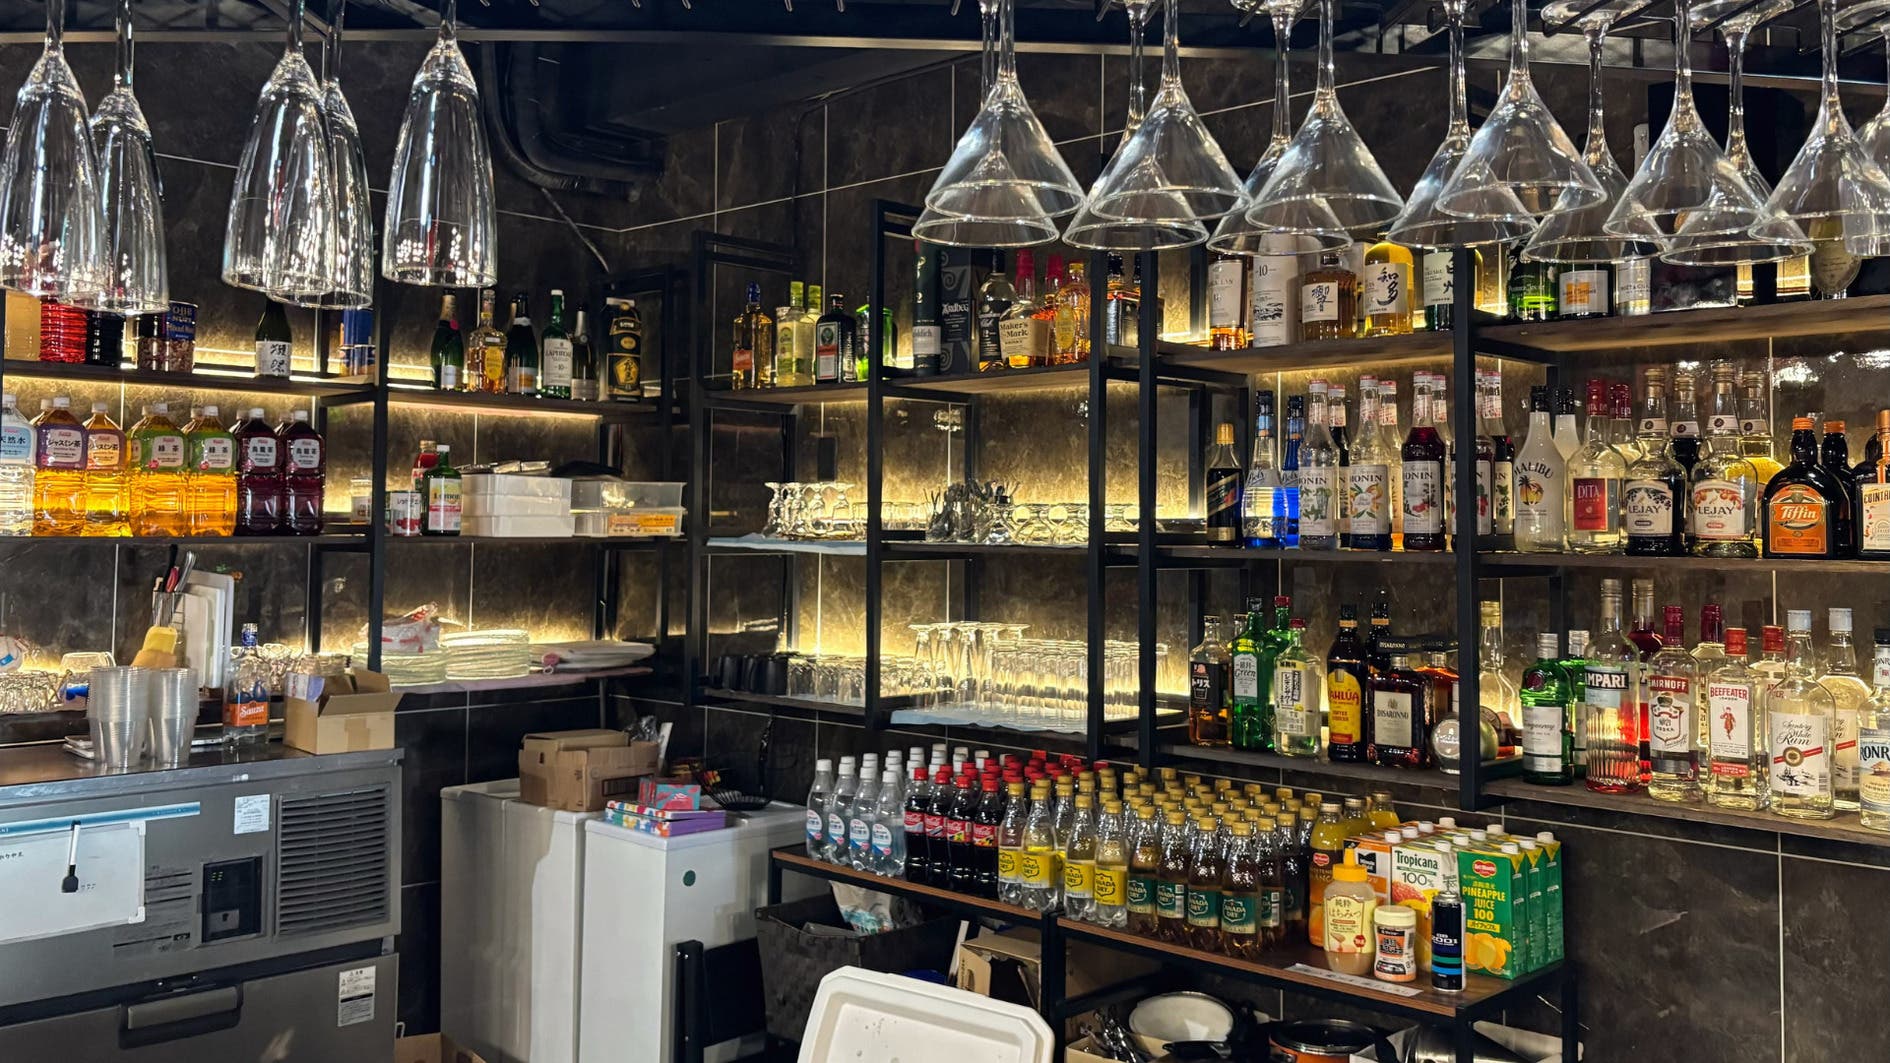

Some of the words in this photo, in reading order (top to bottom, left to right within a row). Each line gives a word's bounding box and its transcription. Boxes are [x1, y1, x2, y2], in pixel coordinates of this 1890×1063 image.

[1259, 264, 1268, 276] 10
[1377, 267, 1399, 306] 知多
[1001, 323, 1028, 332] Maker's
[1007, 329, 1028, 338] Mark
[48, 439, 81, 448] ジャスミン茶
[1514, 461, 1554, 479] MALIBU
[1301, 476, 1327, 484] ONIN
[1404, 471, 1433, 480] ONIN
[1578, 485, 1600, 499] DITA
[1629, 505, 1660, 514] LEJAY
[1698, 506, 1735, 515] LEJAY
[1781, 505, 1817, 519] Tiffin
[1234, 669, 1256, 678] Green
[1191, 679, 1211, 688] トリス
[1586, 673, 1626, 688] MPARI
[1710, 687, 1748, 700] BEEFEATER
[1376, 709, 1409, 719] DISARONNO
[1776, 733, 1811, 746] Rum
[1394, 850, 1439, 870] Tropicana
[1462, 886, 1506, 902] PINEAPPLE
[1474, 899, 1495, 910] JUICE
[1329, 909, 1362, 918] はちみつ
[1473, 908, 1494, 921] 100
[1470, 921, 1497, 930] パイナップル
